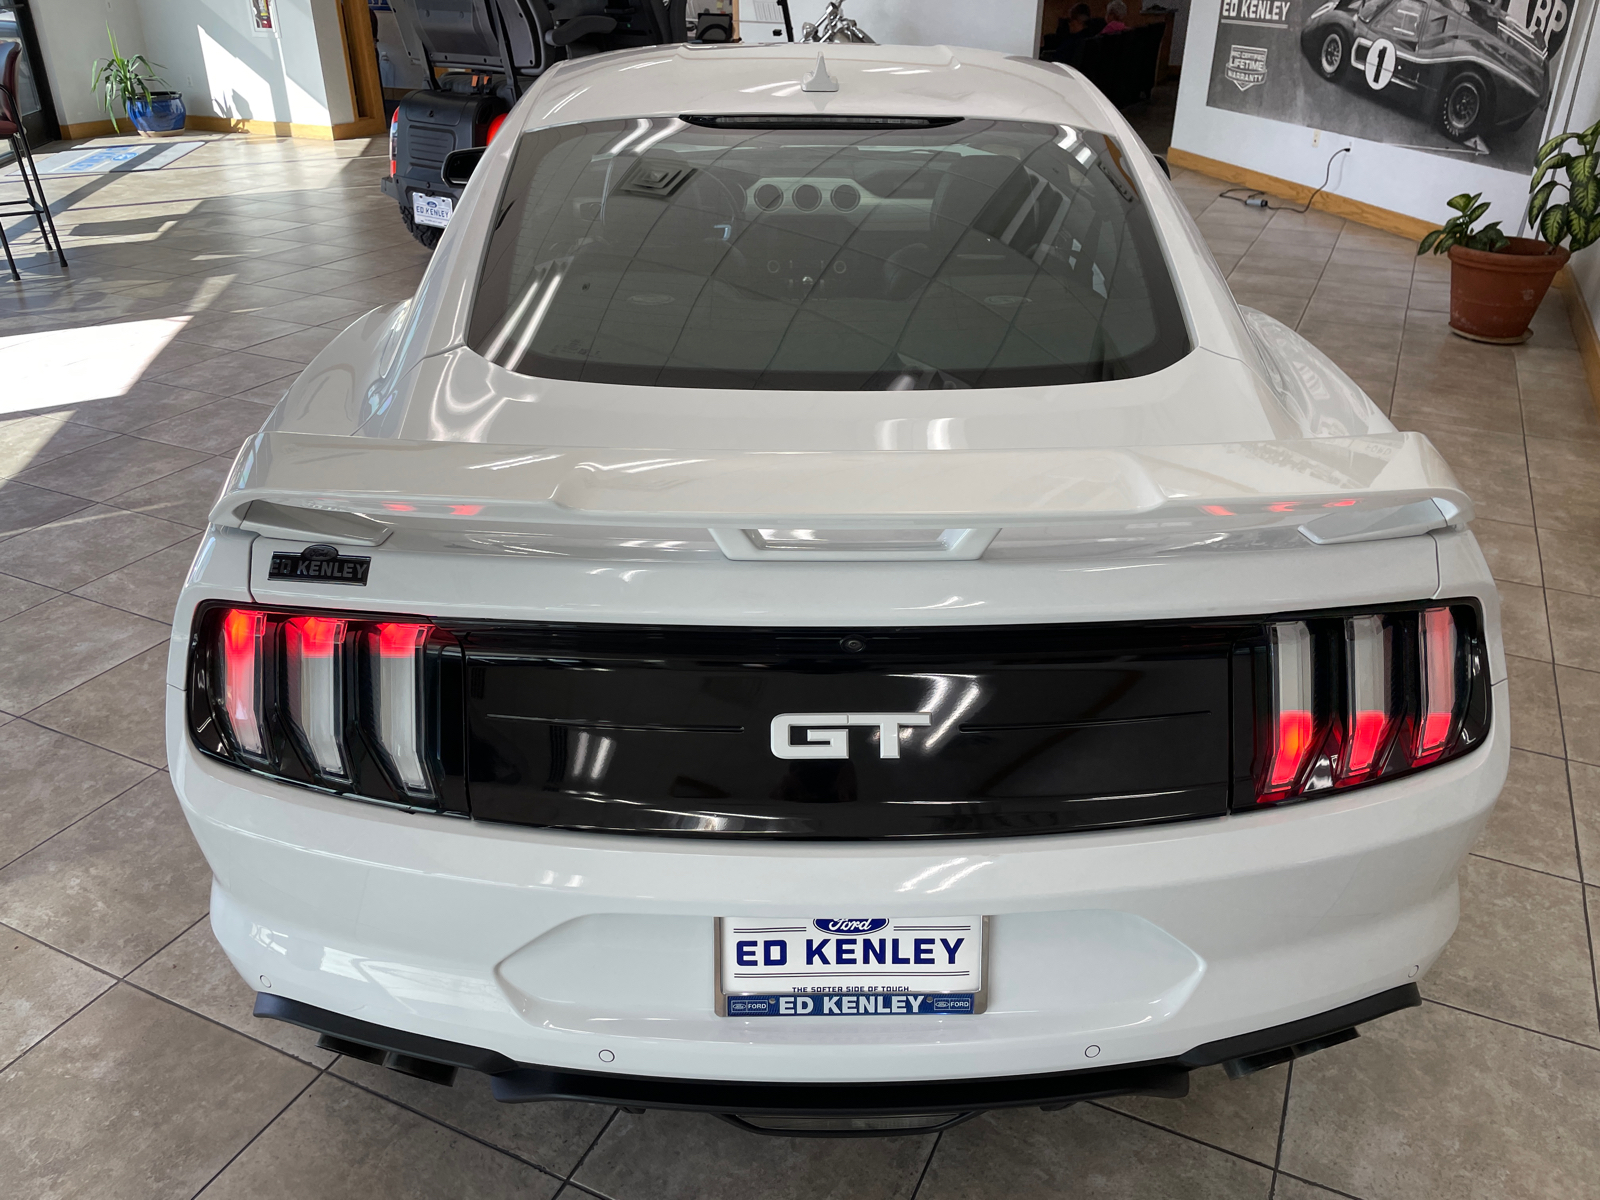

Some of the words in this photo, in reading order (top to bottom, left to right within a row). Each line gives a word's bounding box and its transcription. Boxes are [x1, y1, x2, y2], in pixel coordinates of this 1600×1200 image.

[1222, 0, 1239, 17] ED
[1240, 0, 1291, 21] KENLEY
[1230, 58, 1265, 71] LIFETIME
[1227, 70, 1264, 82] WARRANTY
[425, 207, 449, 218] KENLEY
[270, 558, 292, 574] ED
[297, 560, 368, 579] KENLEY
[770, 712, 932, 760] GT
[828, 918, 873, 931] Ford
[736, 939, 788, 967] ED
[805, 937, 965, 966] KENLEY
[779, 996, 814, 1014] ED
[824, 995, 925, 1014] KENLEY
